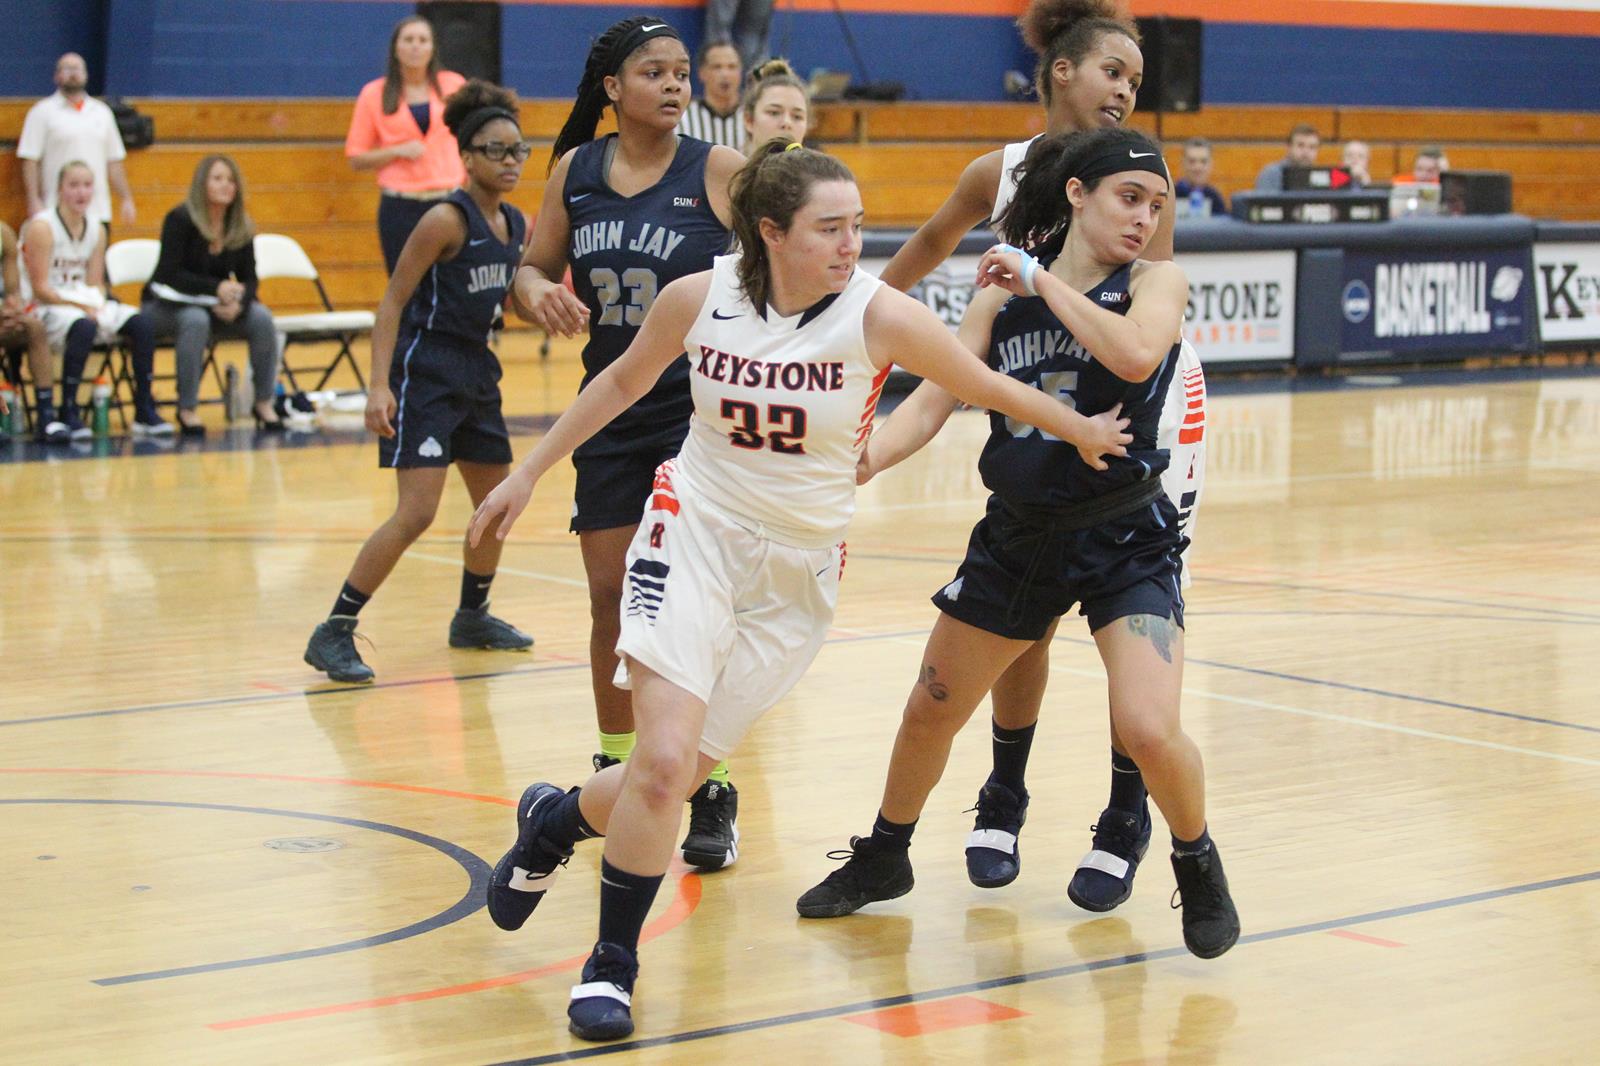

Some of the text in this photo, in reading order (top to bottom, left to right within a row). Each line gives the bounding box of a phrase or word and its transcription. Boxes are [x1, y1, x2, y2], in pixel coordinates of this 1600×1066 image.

[573, 220, 685, 261] JOHN JAY
[467, 263, 507, 294] JOHN
[589, 267, 657, 327] 23
[1184, 282, 1281, 321] STONE
[1375, 262, 1491, 337] BASKETBALL
[697, 345, 844, 392] KEYSTONE
[998, 330, 1062, 375] JOHN
[720, 398, 807, 455] 32
